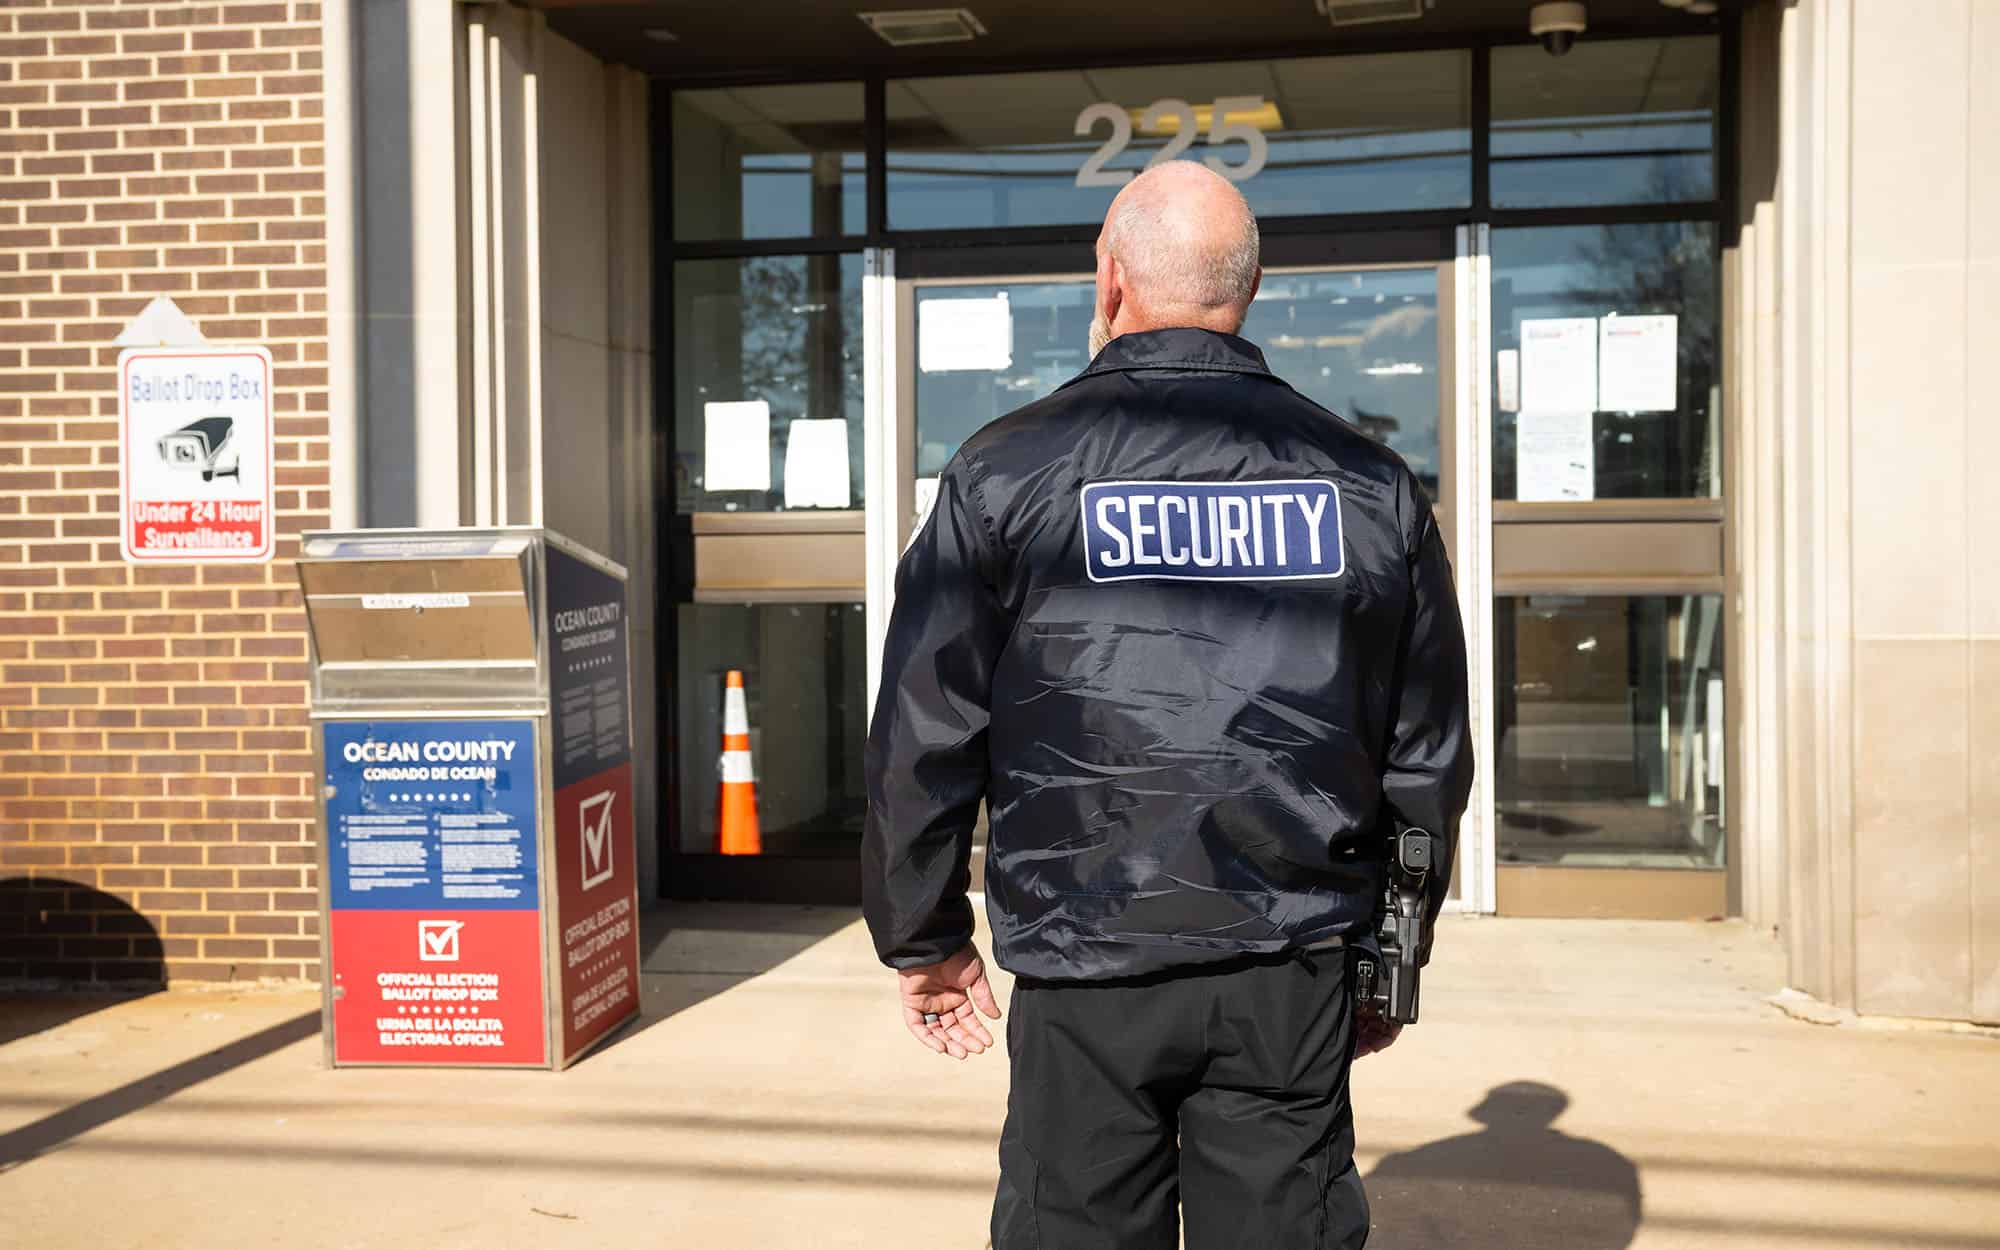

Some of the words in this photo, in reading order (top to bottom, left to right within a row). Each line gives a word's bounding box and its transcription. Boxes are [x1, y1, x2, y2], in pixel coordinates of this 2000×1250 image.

[1074, 95, 1267, 188] 225
[131, 374, 180, 402] Ballot
[184, 373, 222, 407] Drop
[231, 371, 261, 400] Box
[134, 502, 188, 522] Under
[191, 500, 215, 522] 24
[220, 501, 261, 522] Hour
[144, 527, 254, 549] Surveillance
[1096, 494, 1328, 567] SECURITY
[554, 607, 586, 633] OCEAN
[587, 601, 620, 626] COUNTY
[343, 742, 419, 763] OCEAN
[423, 740, 516, 761] COUNTY
[363, 767, 430, 781] CONDADO
[431, 767, 449, 781] DE
[450, 766, 496, 781] OCEAN
[377, 973, 434, 987] OFFICIAL
[435, 973, 499, 987] ELECTION
[381, 988, 432, 1001] BALLOT
[432, 988, 469, 1001] DROP
[470, 988, 499, 1001] BOX
[415, 1018, 433, 1031] DE
[434, 1018, 452, 1031] LA
[452, 1018, 504, 1031] BOLETA
[380, 1032, 452, 1046] ELECTORAL
[453, 1033, 505, 1046] OFICIAL
